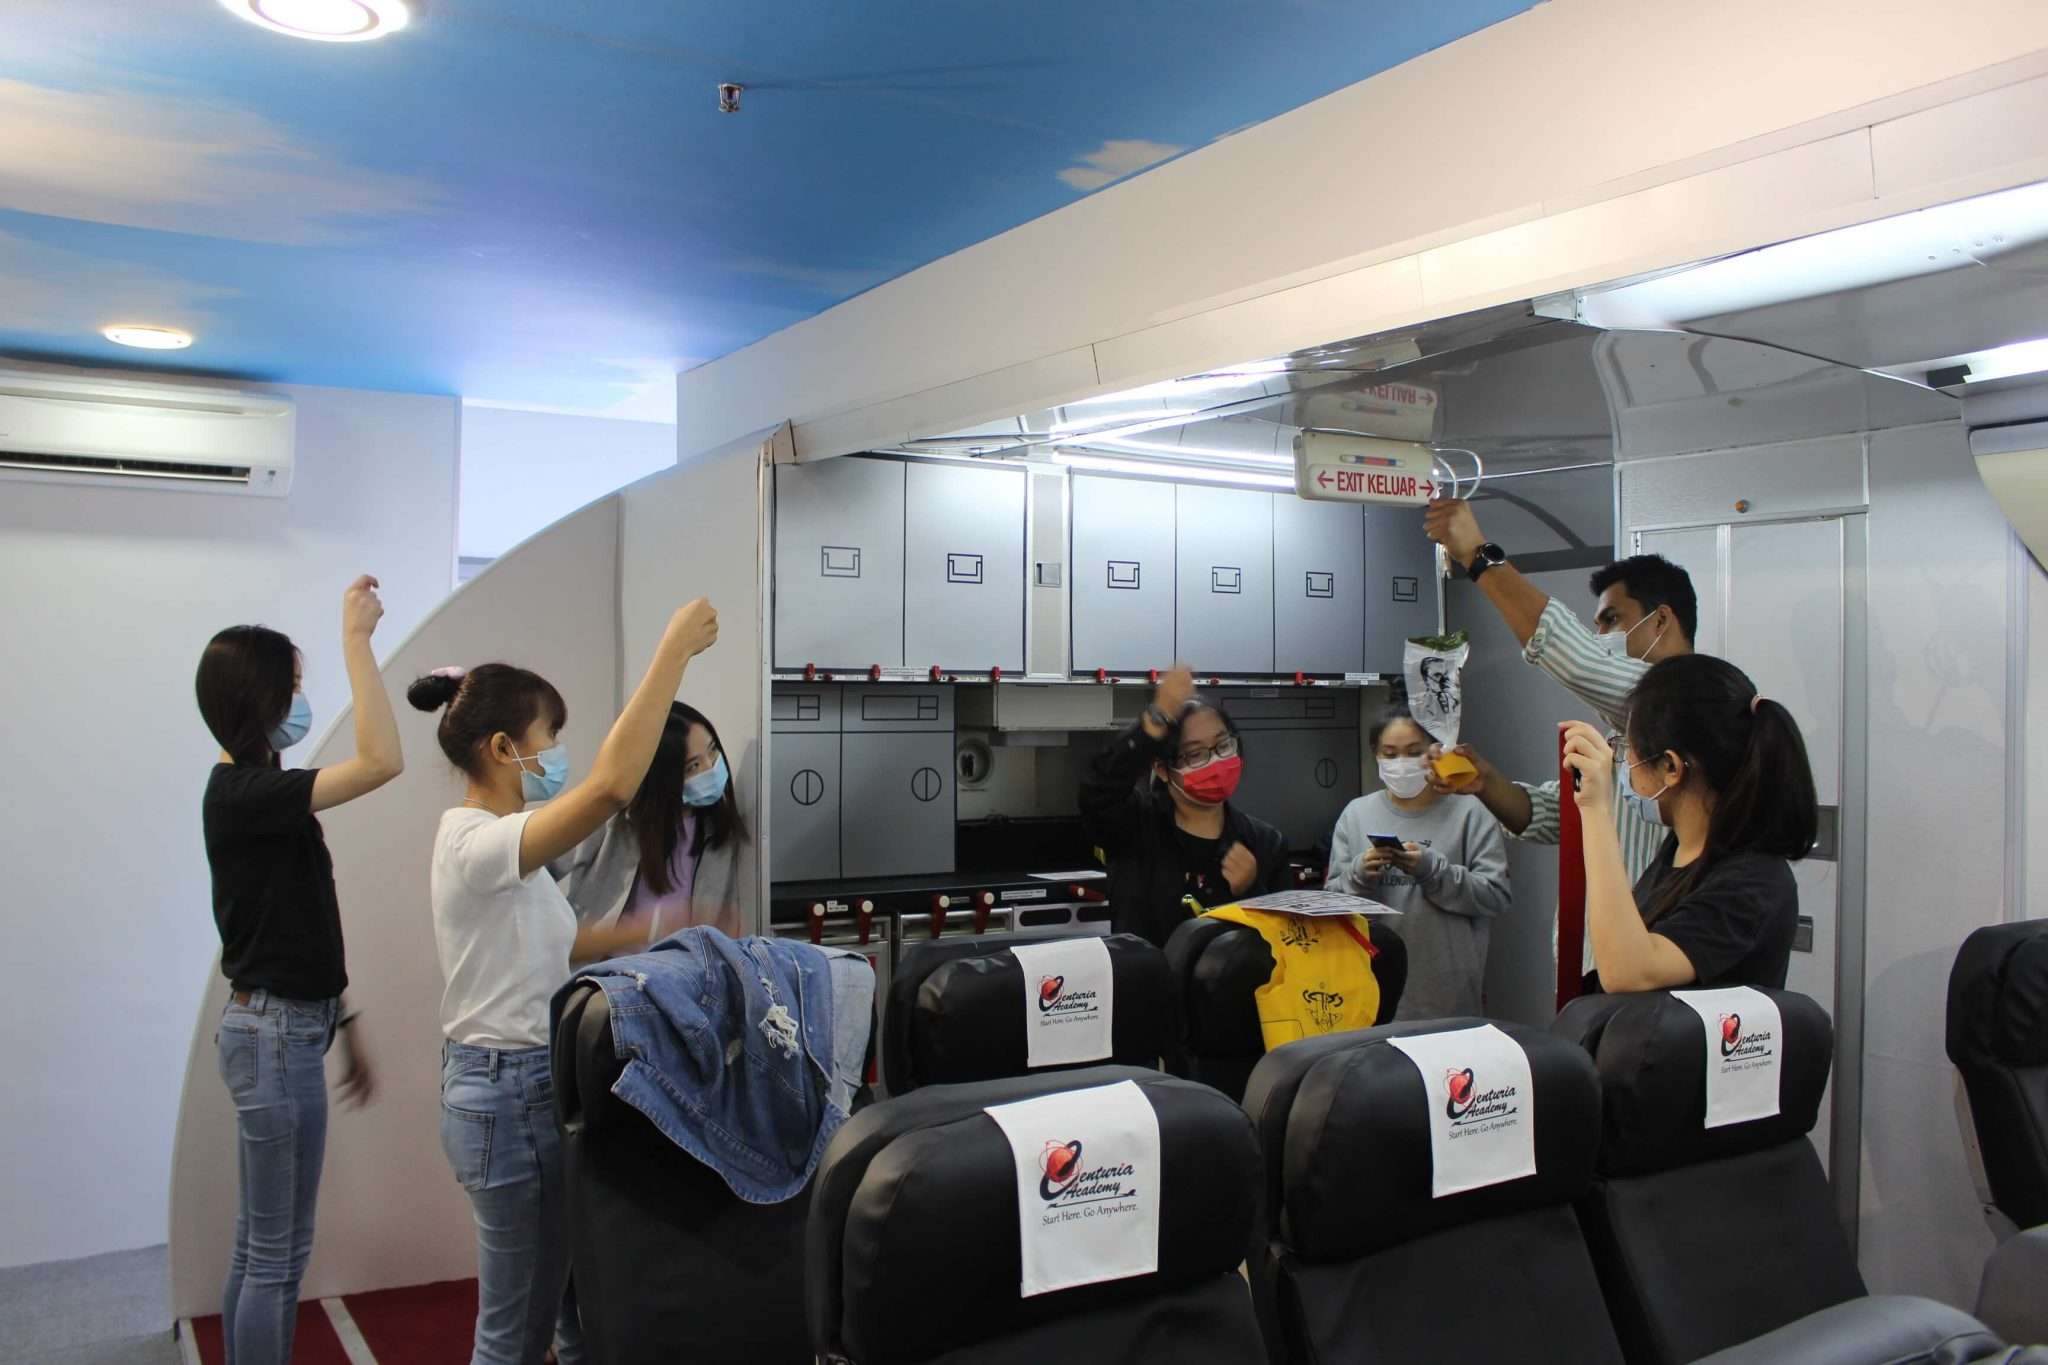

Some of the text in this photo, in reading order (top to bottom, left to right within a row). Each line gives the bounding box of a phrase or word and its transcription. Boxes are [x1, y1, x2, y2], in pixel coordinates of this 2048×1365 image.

[1337, 471, 1416, 497] EXIT KELUAR
[1053, 1001, 1088, 1012] Academy
[1734, 1045, 1764, 1056] Academy
[1465, 1102, 1507, 1119] Academy
[1063, 1182, 1121, 1200] Academy
[1042, 1212, 1060, 1226] Start
[1083, 1207, 1095, 1217] Go
